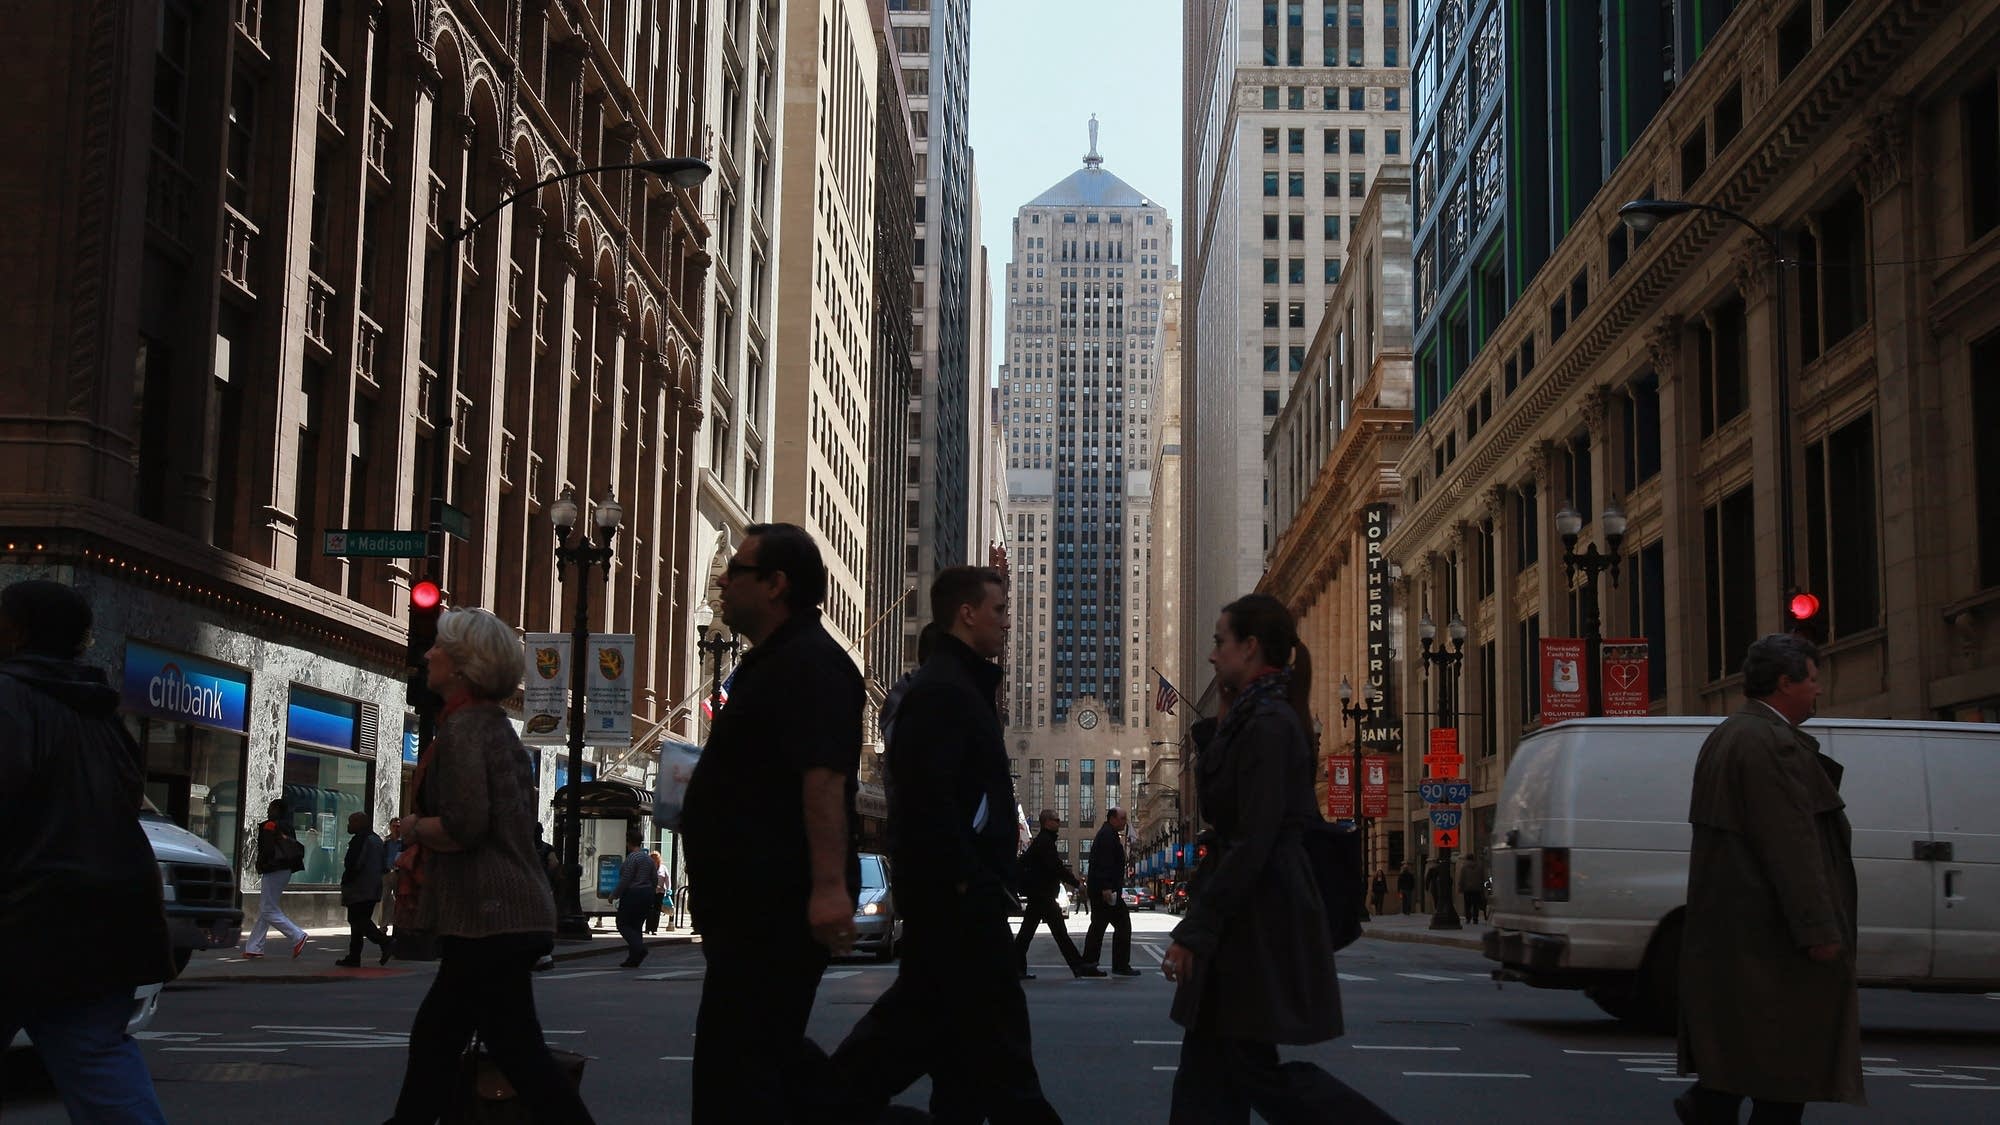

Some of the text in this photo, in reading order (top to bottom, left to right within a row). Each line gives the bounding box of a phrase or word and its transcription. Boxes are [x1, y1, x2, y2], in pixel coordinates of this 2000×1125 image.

[359, 536, 412, 551] Madison
[1367, 511, 1384, 719] NORTHERN TRUST
[149, 671, 223, 720] citibank
[1361, 728, 1401, 743] BANK
[1422, 784, 1442, 799] 90
[1448, 786, 1467, 799] 94
[1434, 813, 1456, 826] 290
